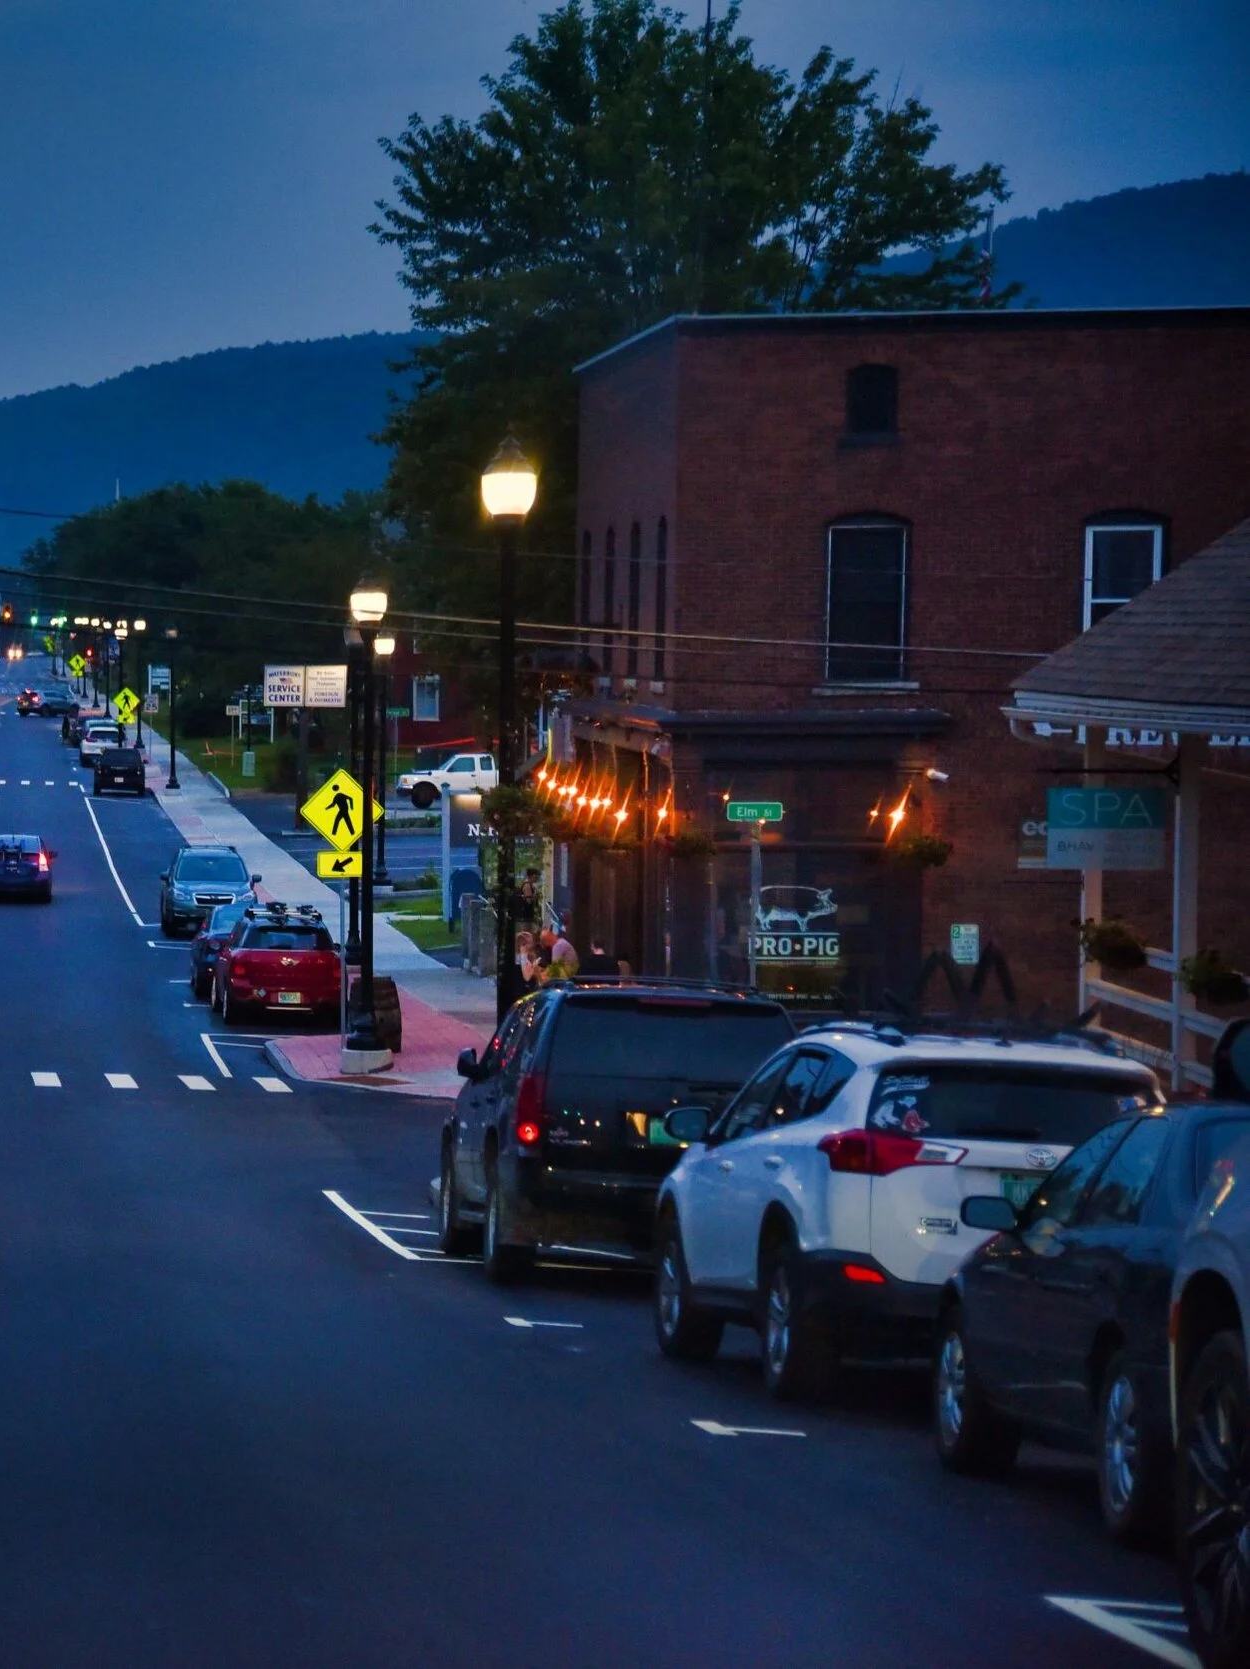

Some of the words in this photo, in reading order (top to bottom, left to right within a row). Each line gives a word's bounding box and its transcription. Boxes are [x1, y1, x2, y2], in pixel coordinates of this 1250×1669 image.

[268, 685, 301, 693] SERVICE
[737, 806, 758, 817] Elm
[1061, 792, 1153, 827] SPA
